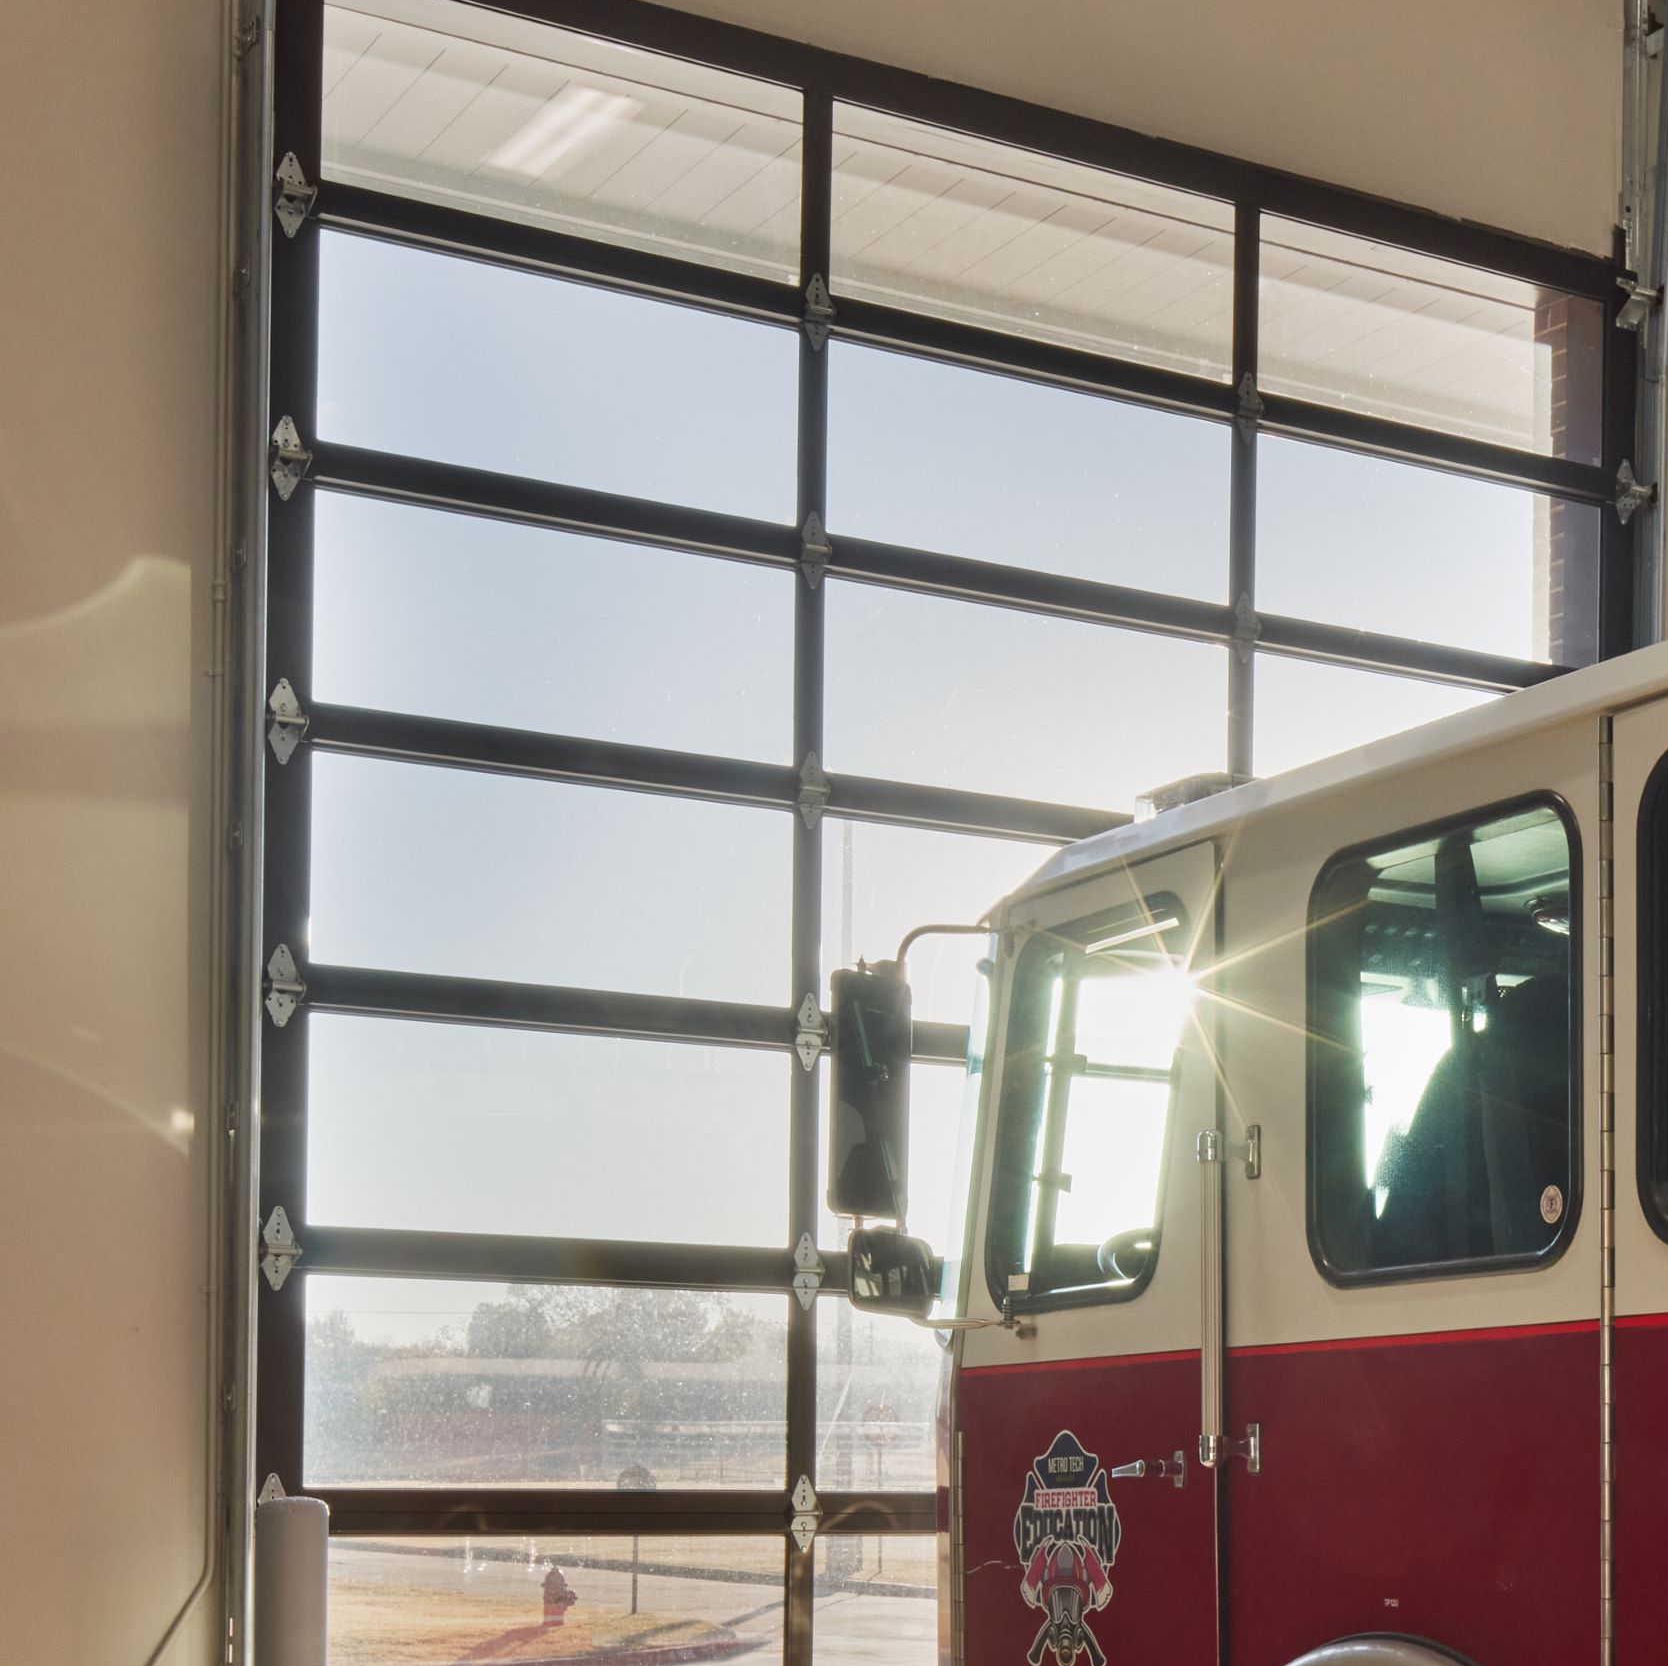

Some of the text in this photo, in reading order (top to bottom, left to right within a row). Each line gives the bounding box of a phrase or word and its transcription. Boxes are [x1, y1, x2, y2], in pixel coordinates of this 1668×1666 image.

[1048, 1457, 1084, 1473] METRO TECH
[1035, 1491, 1097, 1508] FIREFIGHTER
[1020, 1503, 1115, 1564] EDUCATION
